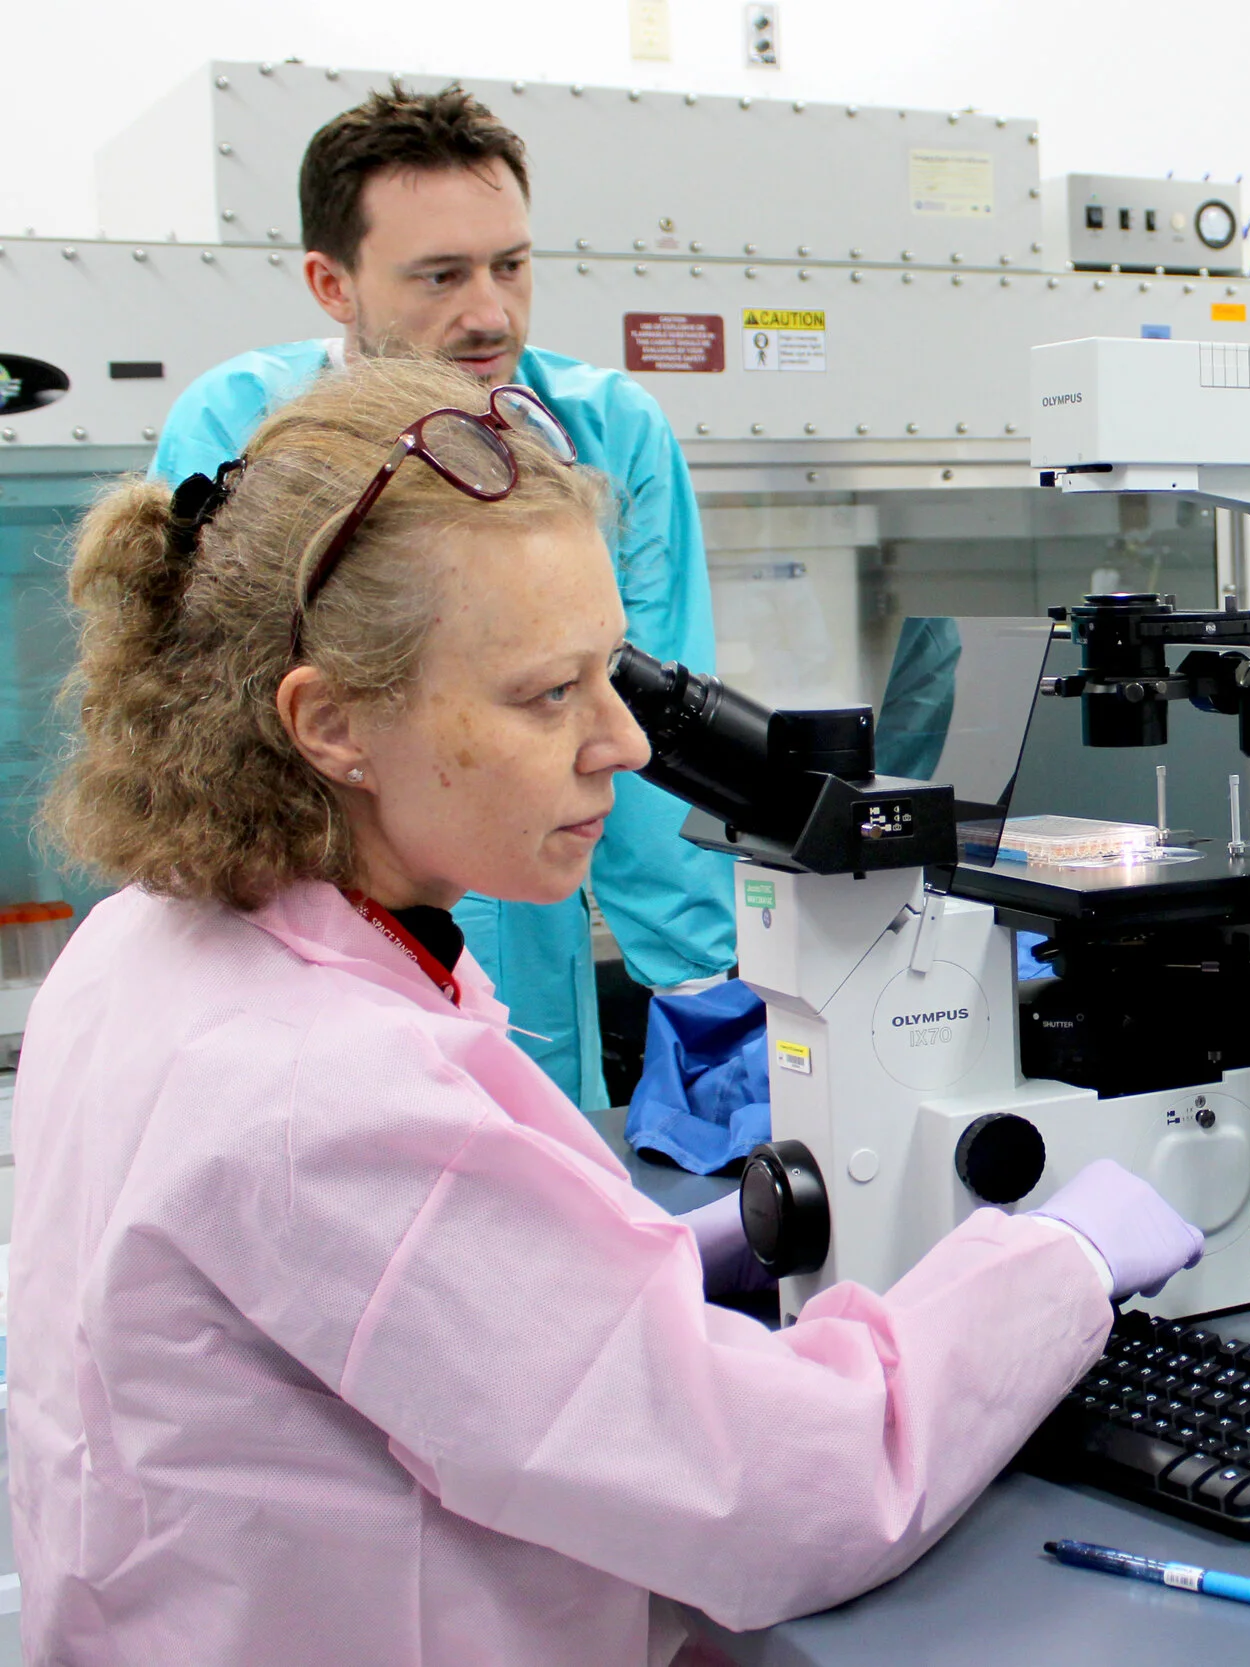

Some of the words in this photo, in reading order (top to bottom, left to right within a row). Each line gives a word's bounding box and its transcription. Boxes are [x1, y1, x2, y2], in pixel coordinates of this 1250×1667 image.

[760, 310, 823, 326] CAUTION
[1042, 392, 1083, 407] OLYMPUS
[372, 917, 395, 943] SPACE
[393, 937, 418, 962] TANGO
[892, 1008, 969, 1027] OLYMPUS
[1043, 1021, 1074, 1029] SHUTTER
[910, 1026, 953, 1048] IX70
